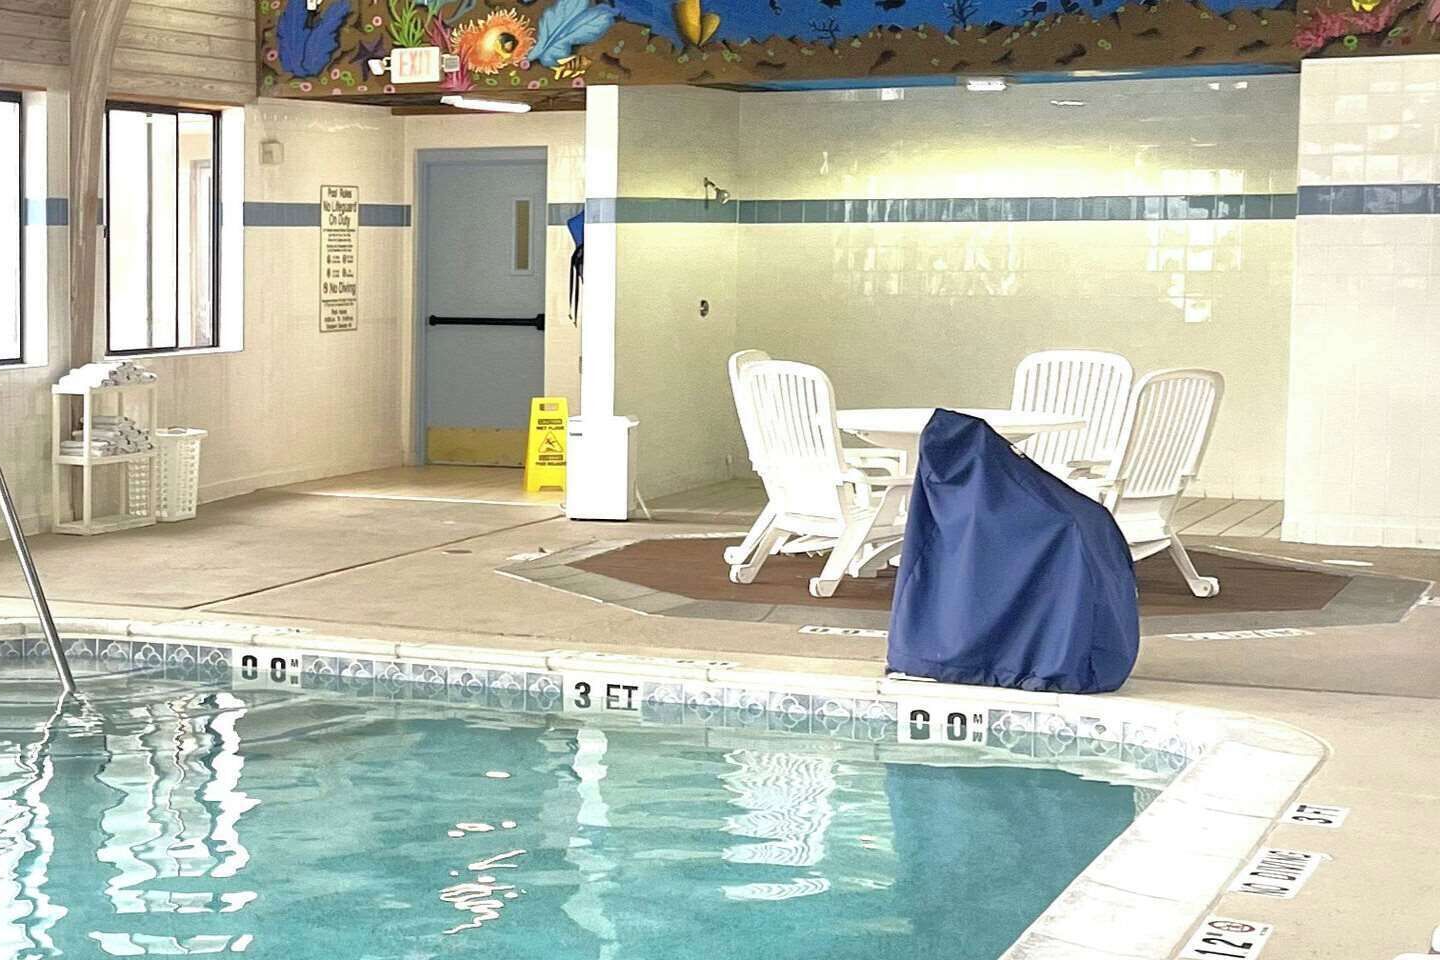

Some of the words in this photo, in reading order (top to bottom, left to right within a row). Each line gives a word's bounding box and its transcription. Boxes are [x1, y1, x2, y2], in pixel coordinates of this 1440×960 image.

[399, 50, 432, 77] EXIT
[328, 188, 337, 198] Pool
[323, 201, 331, 212] No
[332, 201, 357, 214] Lifeguard
[329, 214, 337, 226] On
[338, 214, 350, 228] Duty
[330, 283, 338, 294] No
[339, 282, 356, 296] Diving
[575, 682, 591, 708] 3
